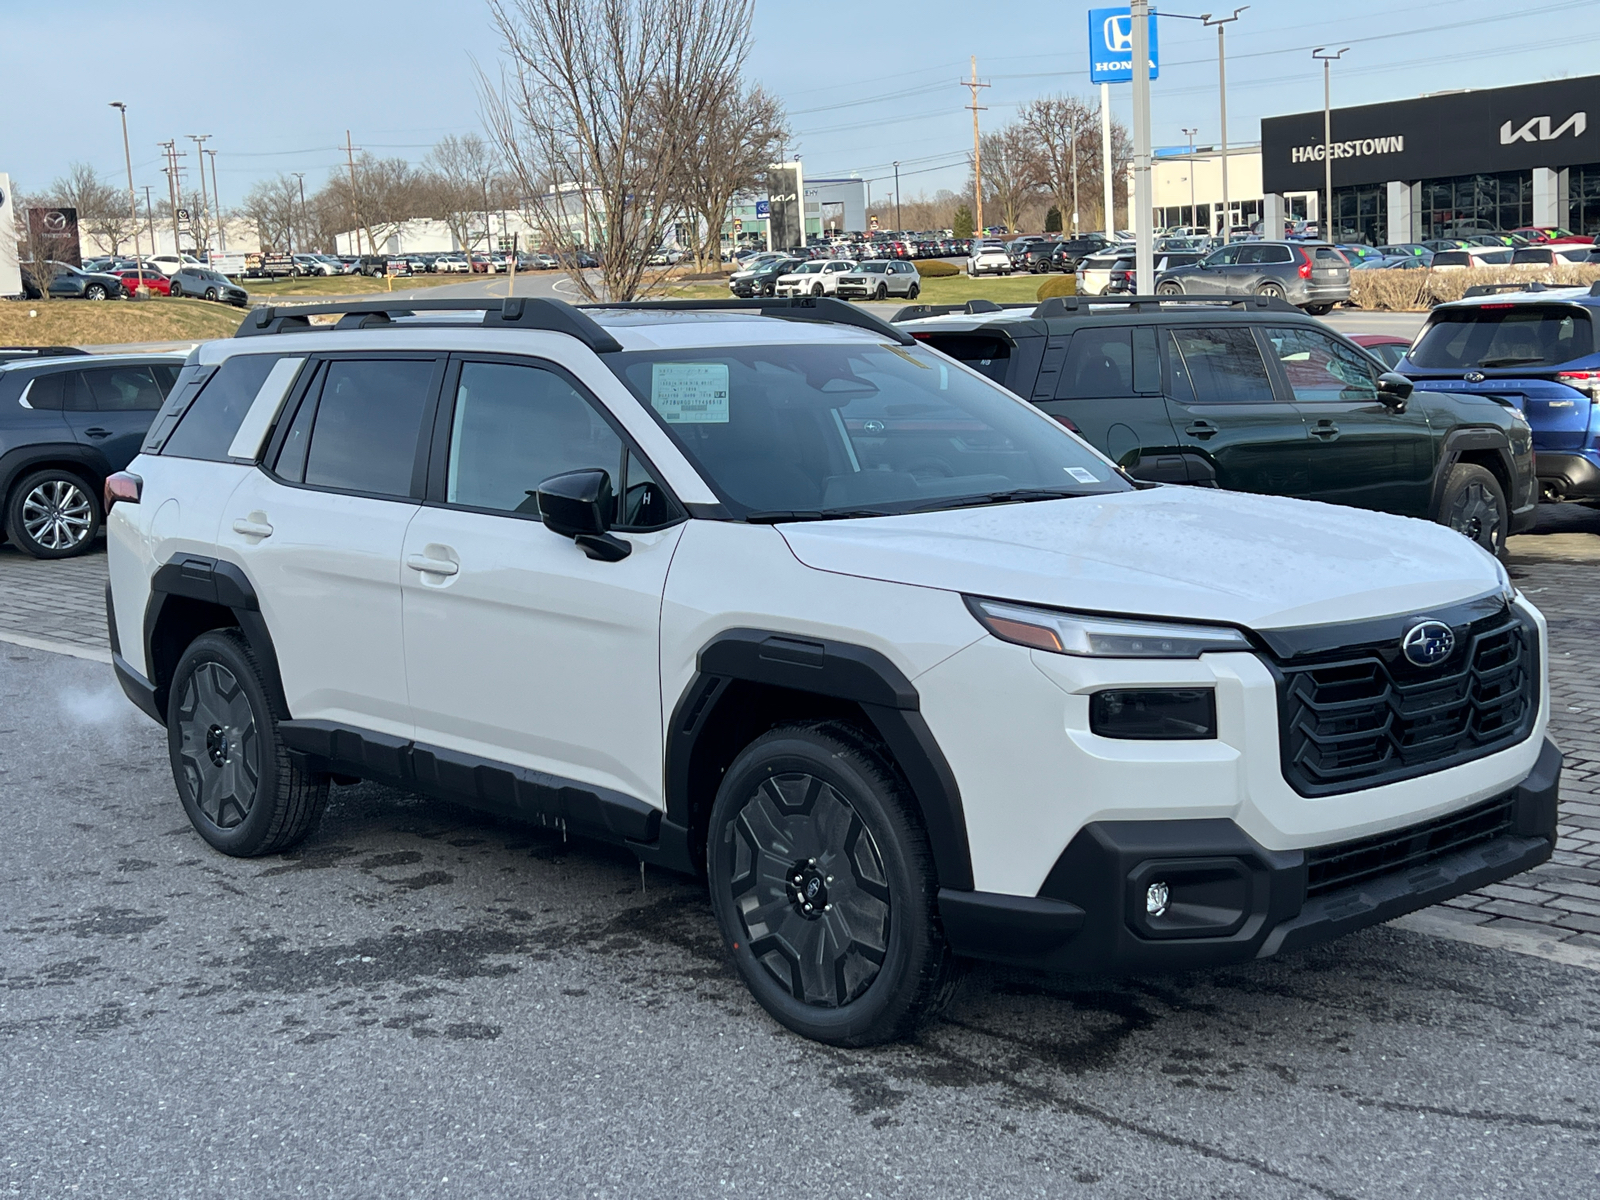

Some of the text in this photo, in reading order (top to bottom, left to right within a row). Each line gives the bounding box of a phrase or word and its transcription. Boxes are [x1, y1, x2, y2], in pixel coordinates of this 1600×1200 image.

[1095, 60, 1156, 71] HONA
[1500, 112, 1586, 145] KIA
[1292, 136, 1403, 163] HAGERSTOWN
[771, 193, 796, 202] KIA
